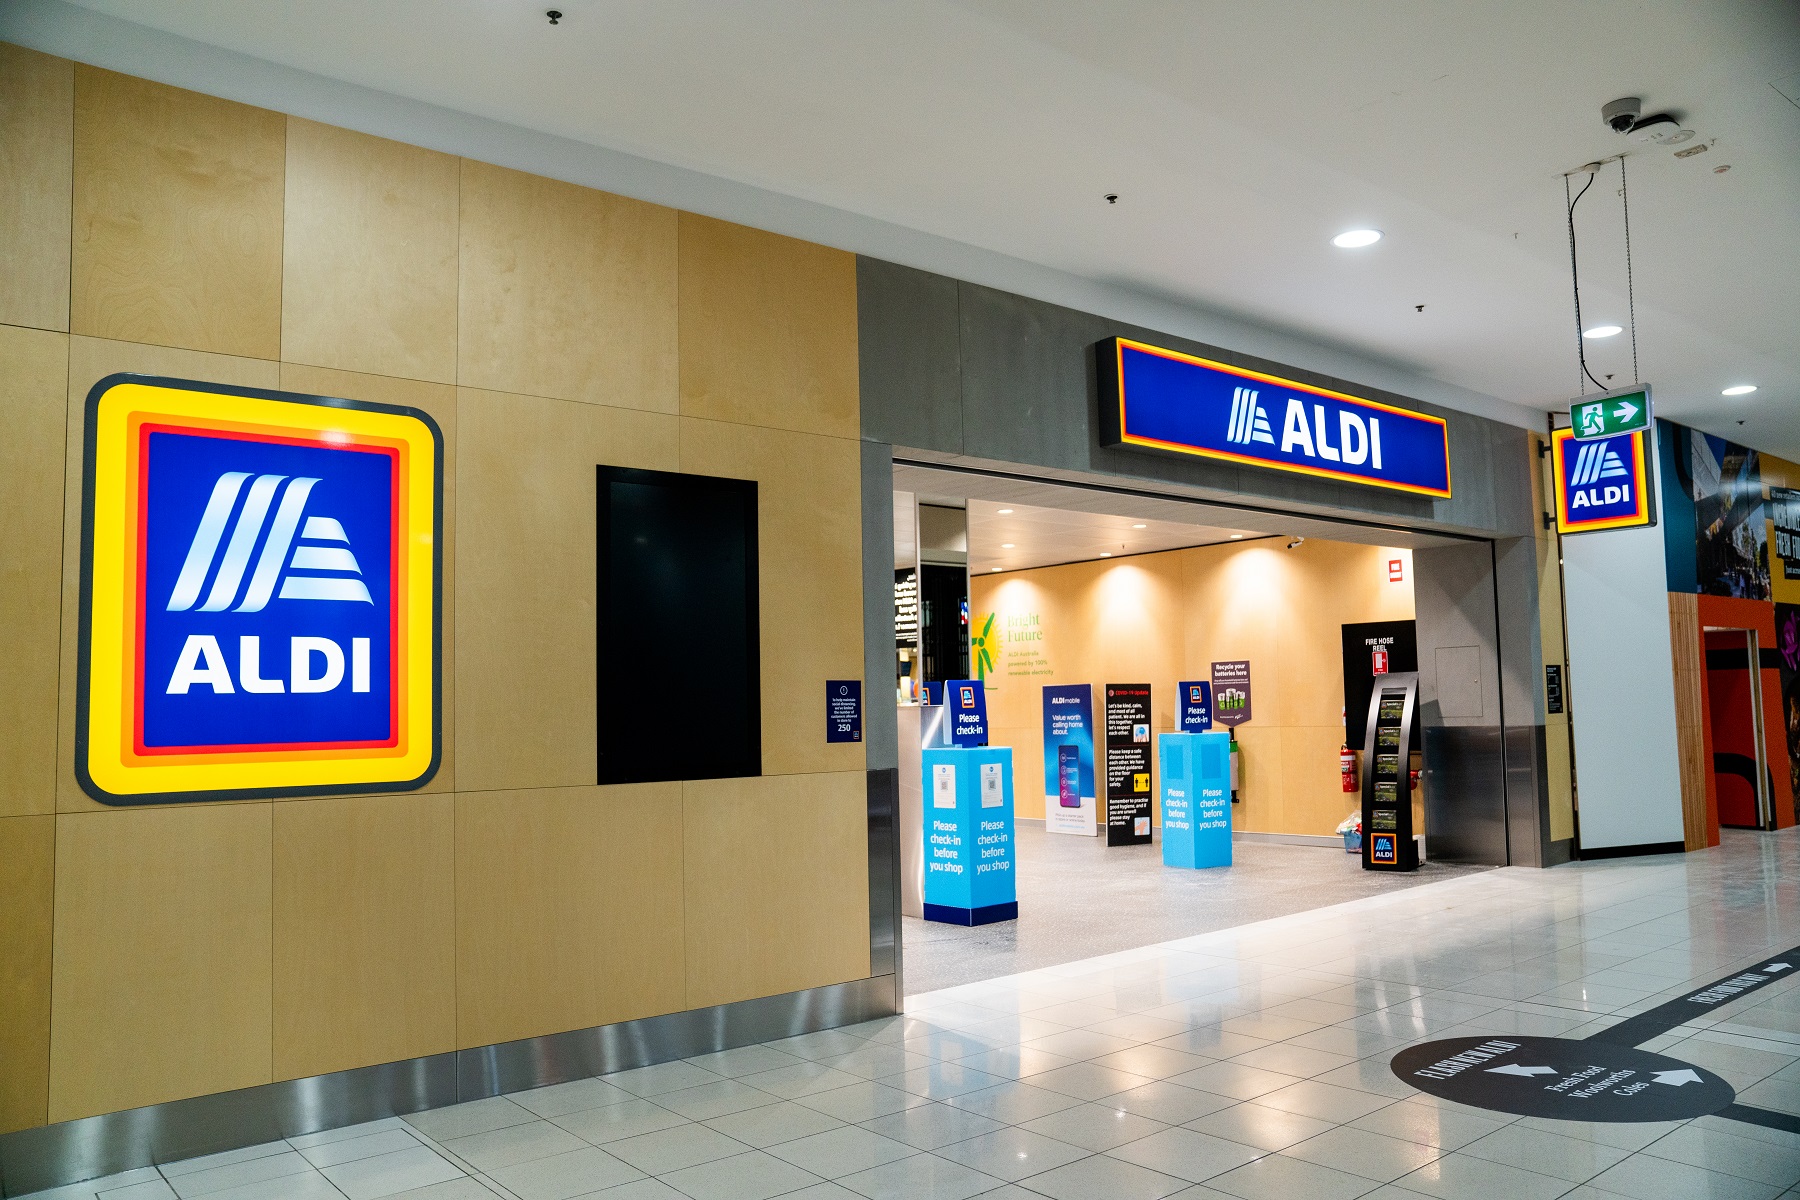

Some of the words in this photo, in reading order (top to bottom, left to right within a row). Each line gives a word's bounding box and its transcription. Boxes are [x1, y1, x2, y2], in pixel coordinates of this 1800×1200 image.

[1281, 398, 1381, 470] ALDI
[1572, 482, 1630, 509] ALDI
[1008, 612, 1039, 628] Bright
[1008, 630, 1042, 642] Future
[166, 634, 370, 695] ALDI
[959, 714, 979, 722] Please
[1185, 716, 1208, 724] check-in
[956, 725, 983, 735] check-in
[1168, 789, 1184, 797] Please
[1202, 789, 1222, 797] Please
[1166, 799, 1188, 808] check-in
[1200, 798, 1225, 808] check-in
[1168, 809, 1185, 818] before
[1203, 809, 1222, 818] before
[933, 821, 957, 831] Please
[981, 821, 1004, 831] Please
[1166, 820, 1175, 828] you
[1175, 820, 1189, 830] shop
[1200, 821, 1211, 831] you
[1212, 819, 1226, 828] shop
[930, 834, 961, 845] check-in
[978, 833, 1008, 845] check-in
[934, 848, 958, 858] before
[981, 847, 1004, 858] before
[930, 862, 944, 872] you
[944, 862, 963, 875] shop
[977, 863, 991, 875] you
[992, 860, 1010, 872] shop
[1475, 1040, 1521, 1054] ALDI
[1544, 1078, 1584, 1092] Fresh
[1571, 1065, 1607, 1078] Food
[1568, 1070, 1636, 1098] Woolworths
[1613, 1082, 1650, 1096] Coles
